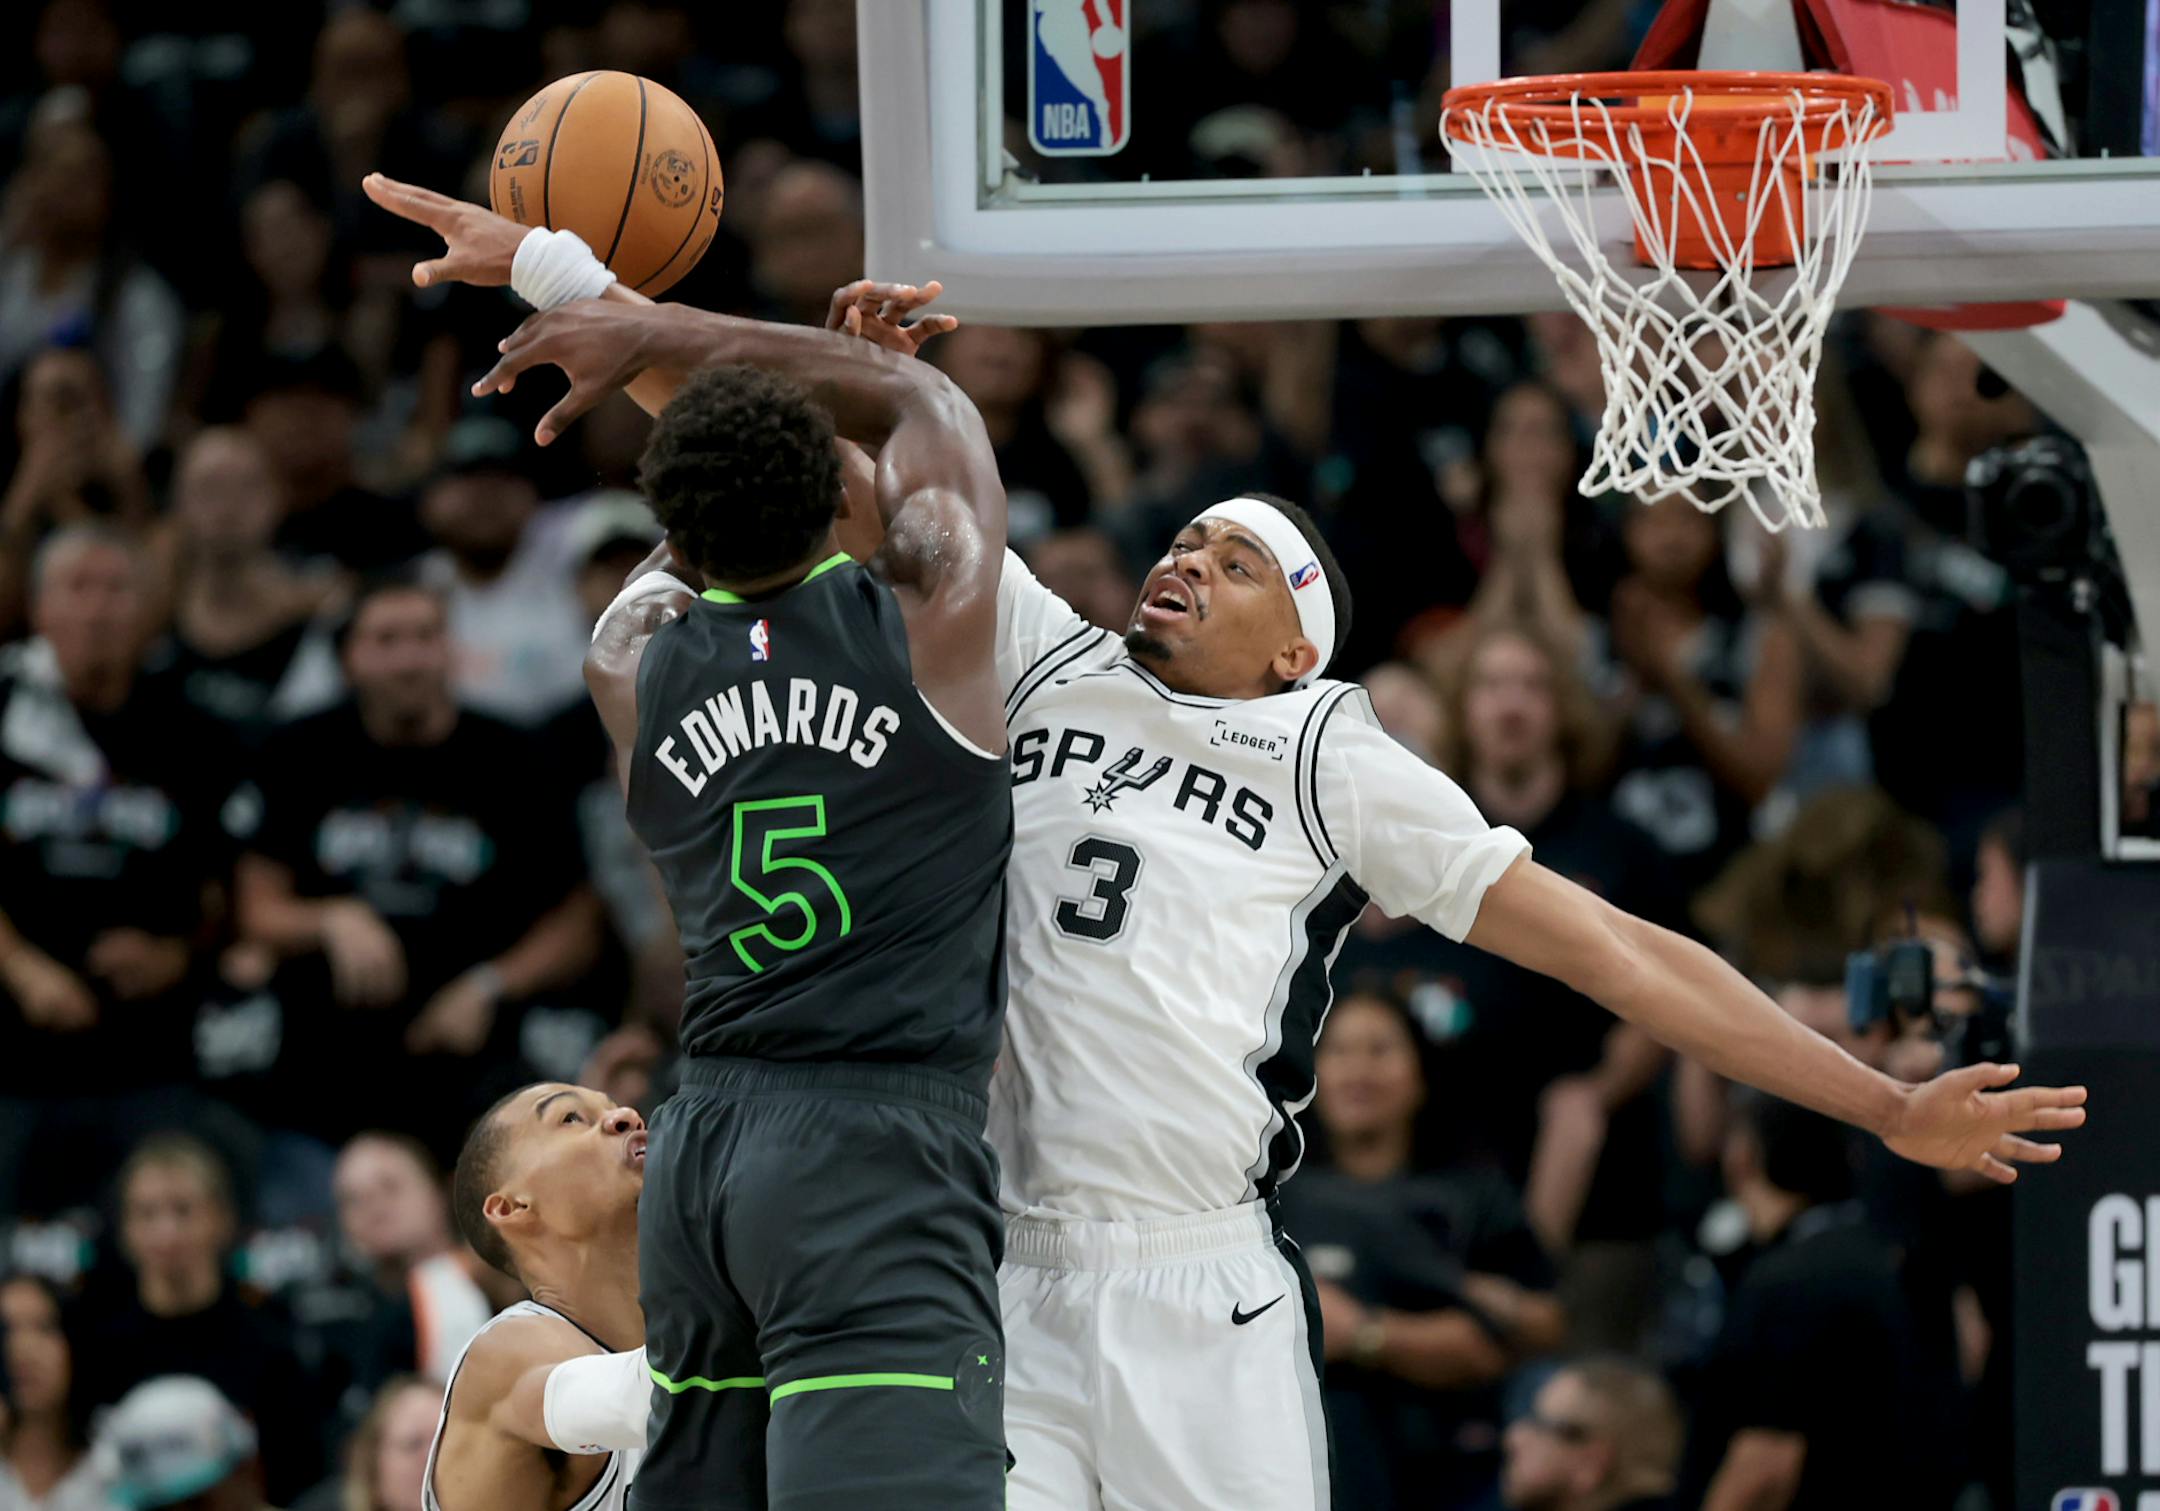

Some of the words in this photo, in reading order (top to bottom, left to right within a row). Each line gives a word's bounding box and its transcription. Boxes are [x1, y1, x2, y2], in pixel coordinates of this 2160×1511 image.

[1043, 103, 1091, 139] NBA
[654, 677, 901, 798] EDWARDS
[1011, 727, 1274, 851] SPURS
[1221, 728, 1277, 752] LEDGER
[728, 794, 851, 974] 5
[1051, 832, 1145, 945] 3
